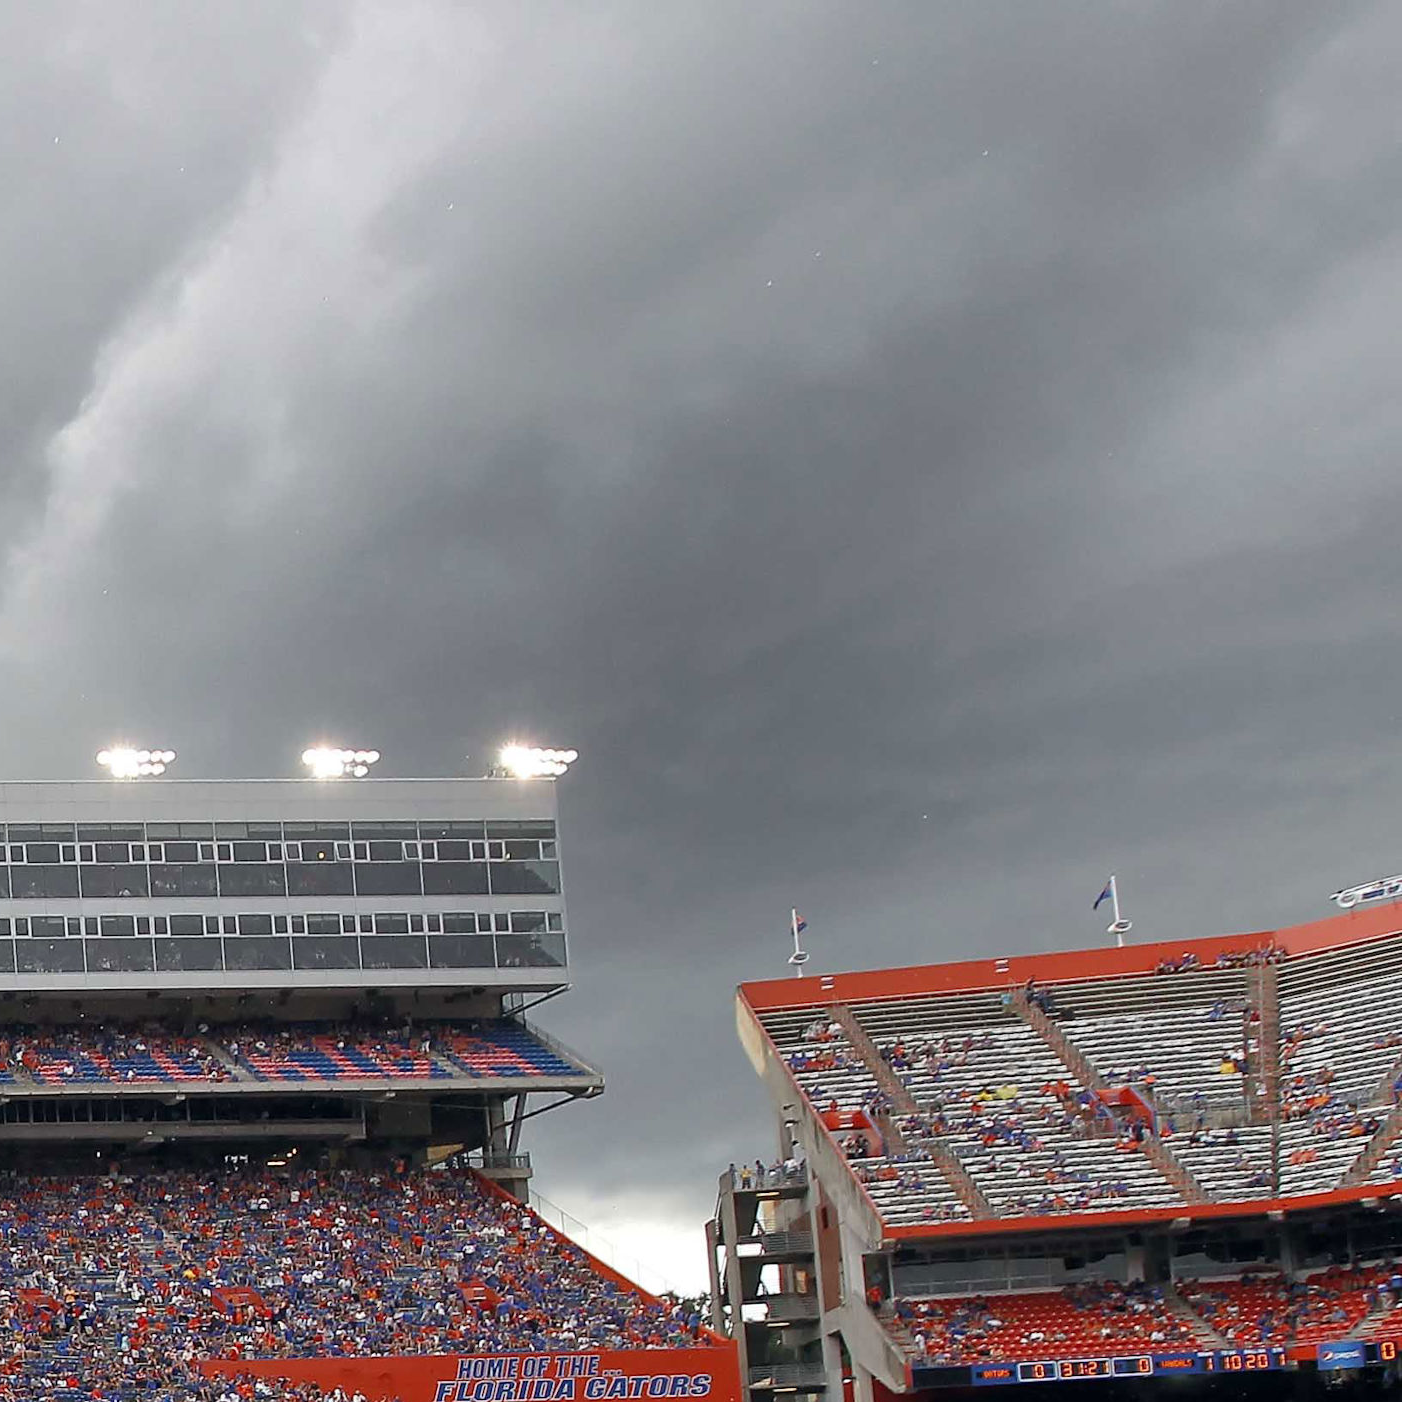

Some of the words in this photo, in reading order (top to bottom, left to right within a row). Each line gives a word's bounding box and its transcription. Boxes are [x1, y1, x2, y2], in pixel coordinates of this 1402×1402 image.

[456, 1357, 518, 1381] HOME
[522, 1356, 550, 1380] OF
[1034, 1364, 1045, 1378] 0
[1138, 1358, 1150, 1373] 0
[584, 1374, 713, 1400] GATORS
